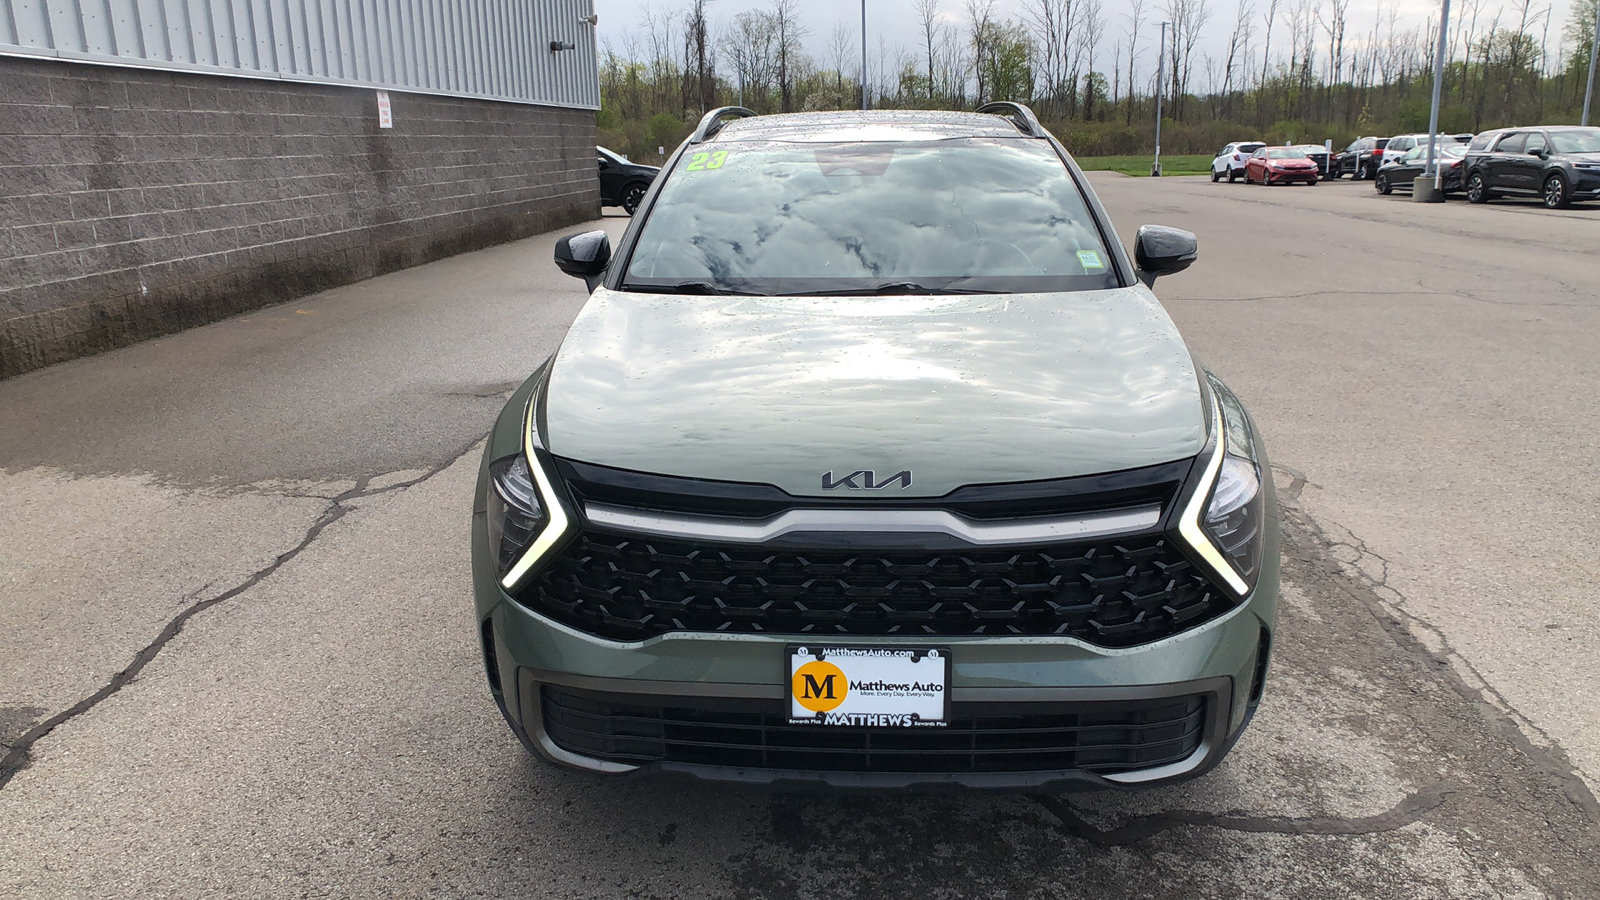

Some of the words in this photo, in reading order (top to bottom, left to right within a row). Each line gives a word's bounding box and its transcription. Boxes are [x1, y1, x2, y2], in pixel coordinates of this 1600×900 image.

[686, 150, 728, 171] 23
[821, 469, 913, 490] KIA
[822, 648, 914, 657] MatthewsAuto.com
[801, 674, 837, 699] M
[850, 680, 910, 692] Matthews
[911, 681, 943, 692] Auto
[824, 713, 913, 727] MATTHEWS
